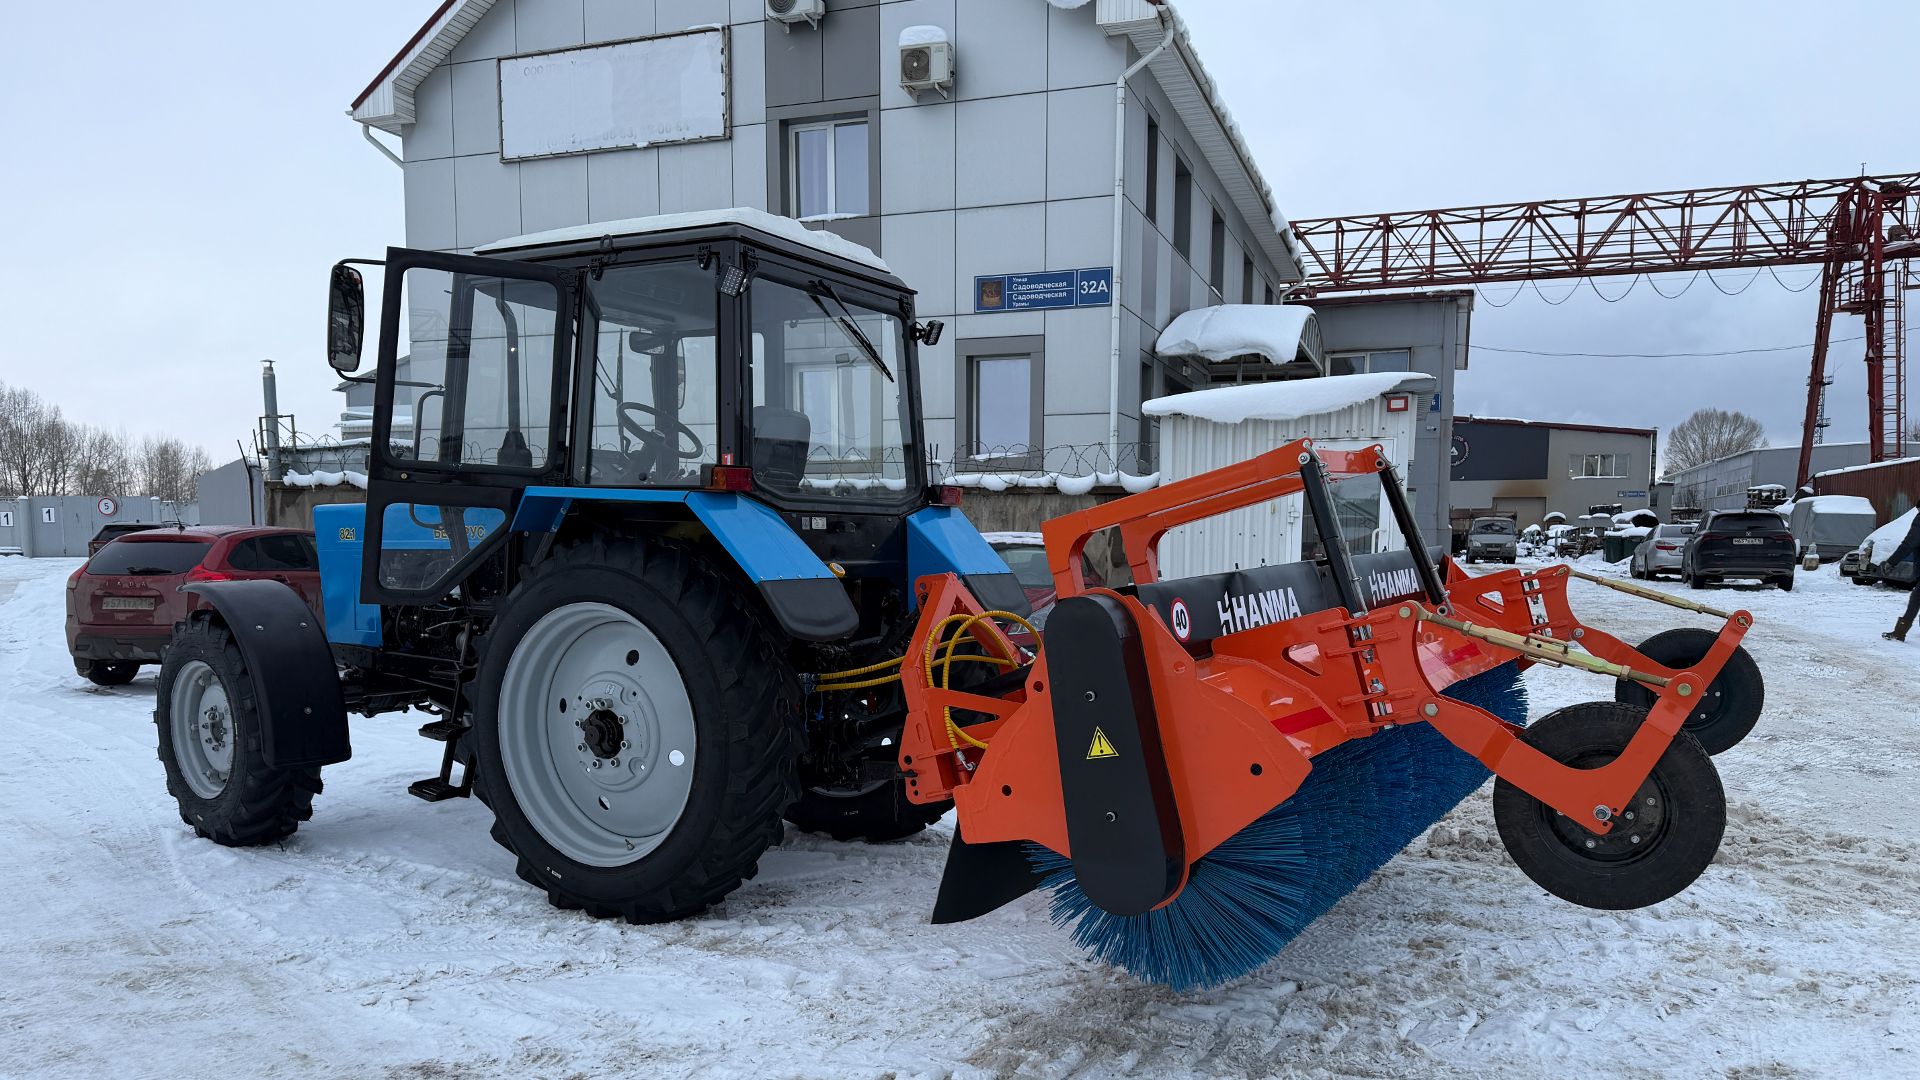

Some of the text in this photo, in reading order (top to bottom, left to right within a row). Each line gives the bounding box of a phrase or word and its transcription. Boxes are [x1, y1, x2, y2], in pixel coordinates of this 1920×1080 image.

[1012, 281, 1067, 290] Садоводческая
[1012, 291, 1067, 300] Садоводческая
[104, 502, 110, 510] 5
[3, 513, 9, 525] 1
[45, 509, 51, 521] 1
[433, 525, 486, 539] БЕРУС
[1376, 567, 1420, 597] HANMA
[1231, 587, 1302, 631] HANMA
[1175, 608, 1188, 630] 40
